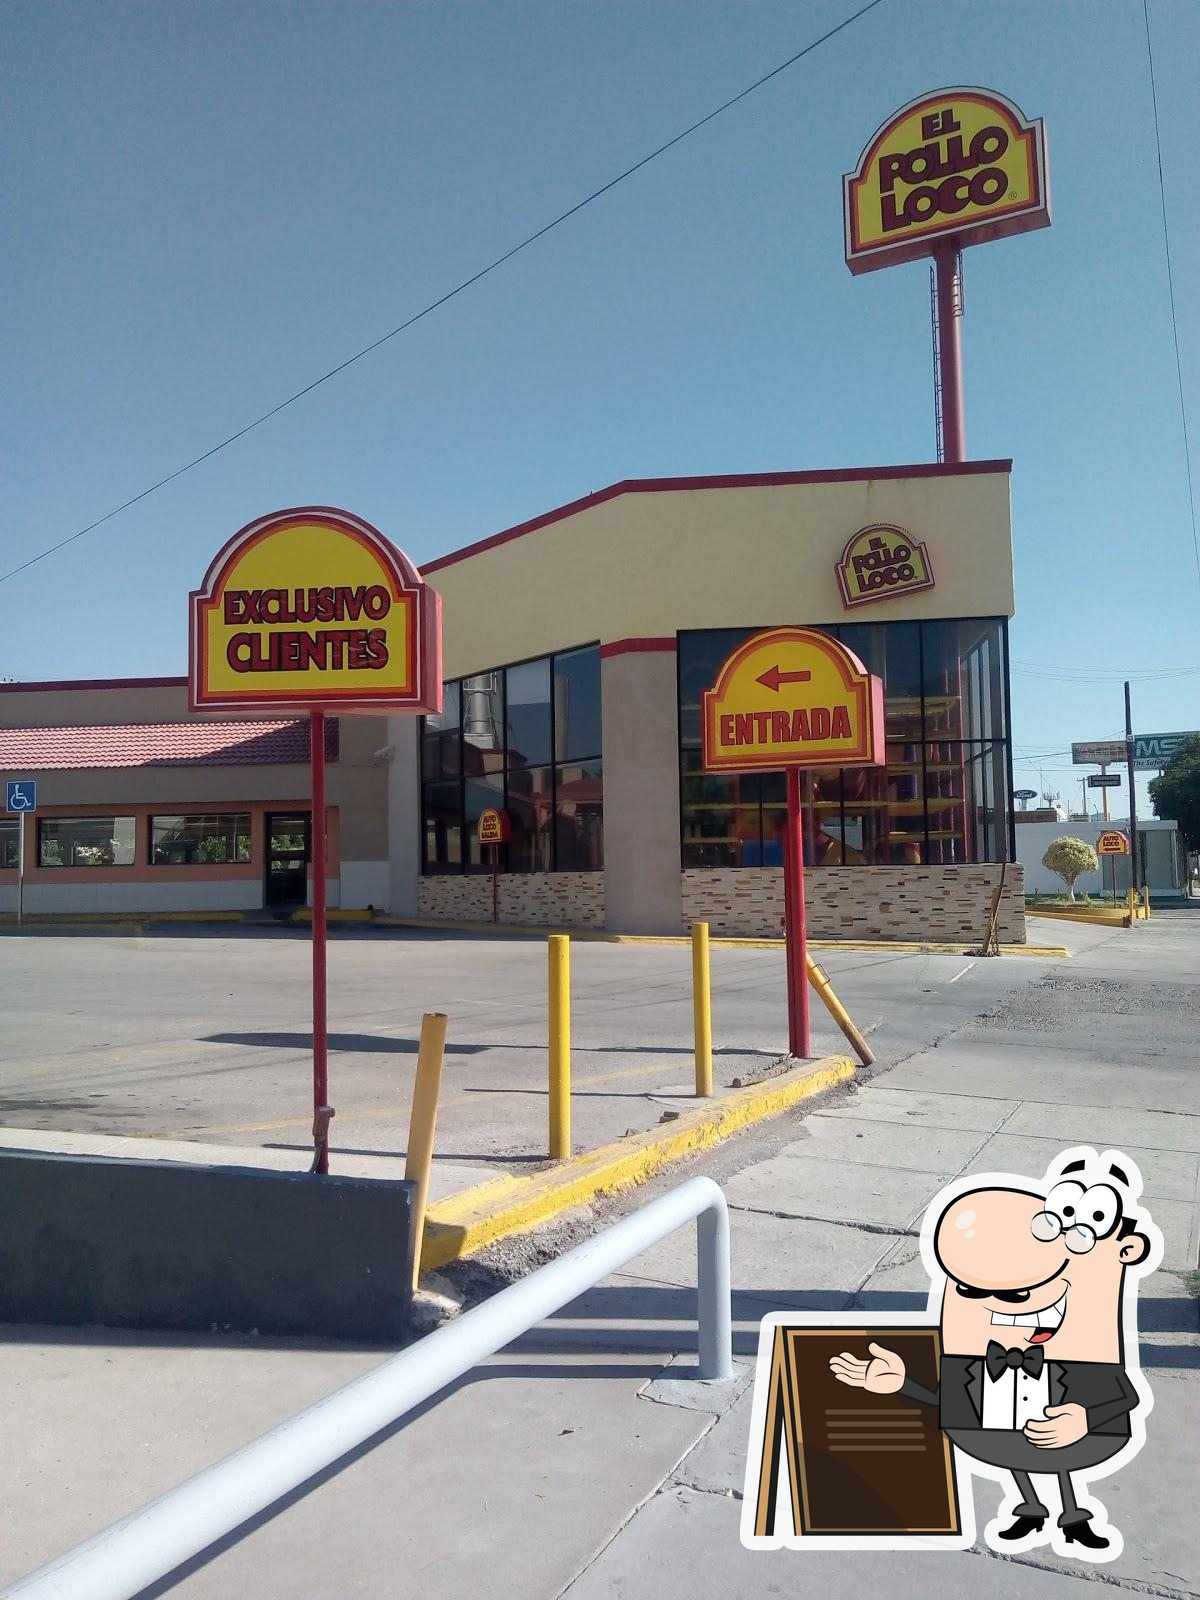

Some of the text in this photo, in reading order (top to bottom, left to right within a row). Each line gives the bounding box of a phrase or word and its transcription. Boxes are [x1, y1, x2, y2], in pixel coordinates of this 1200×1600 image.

[921, 108, 961, 140] EL
[879, 126, 1009, 193] POLLO
[881, 167, 1009, 232] LOCO
[852, 544, 911, 574] POLLO
[869, 537, 887, 551] EL
[856, 564, 915, 592] LOCO
[224, 584, 391, 625] EXCLUSIVO
[226, 628, 389, 673] CLIENTES
[720, 705, 852, 747] ENTRADA
[483, 823, 496, 831] LOCO
